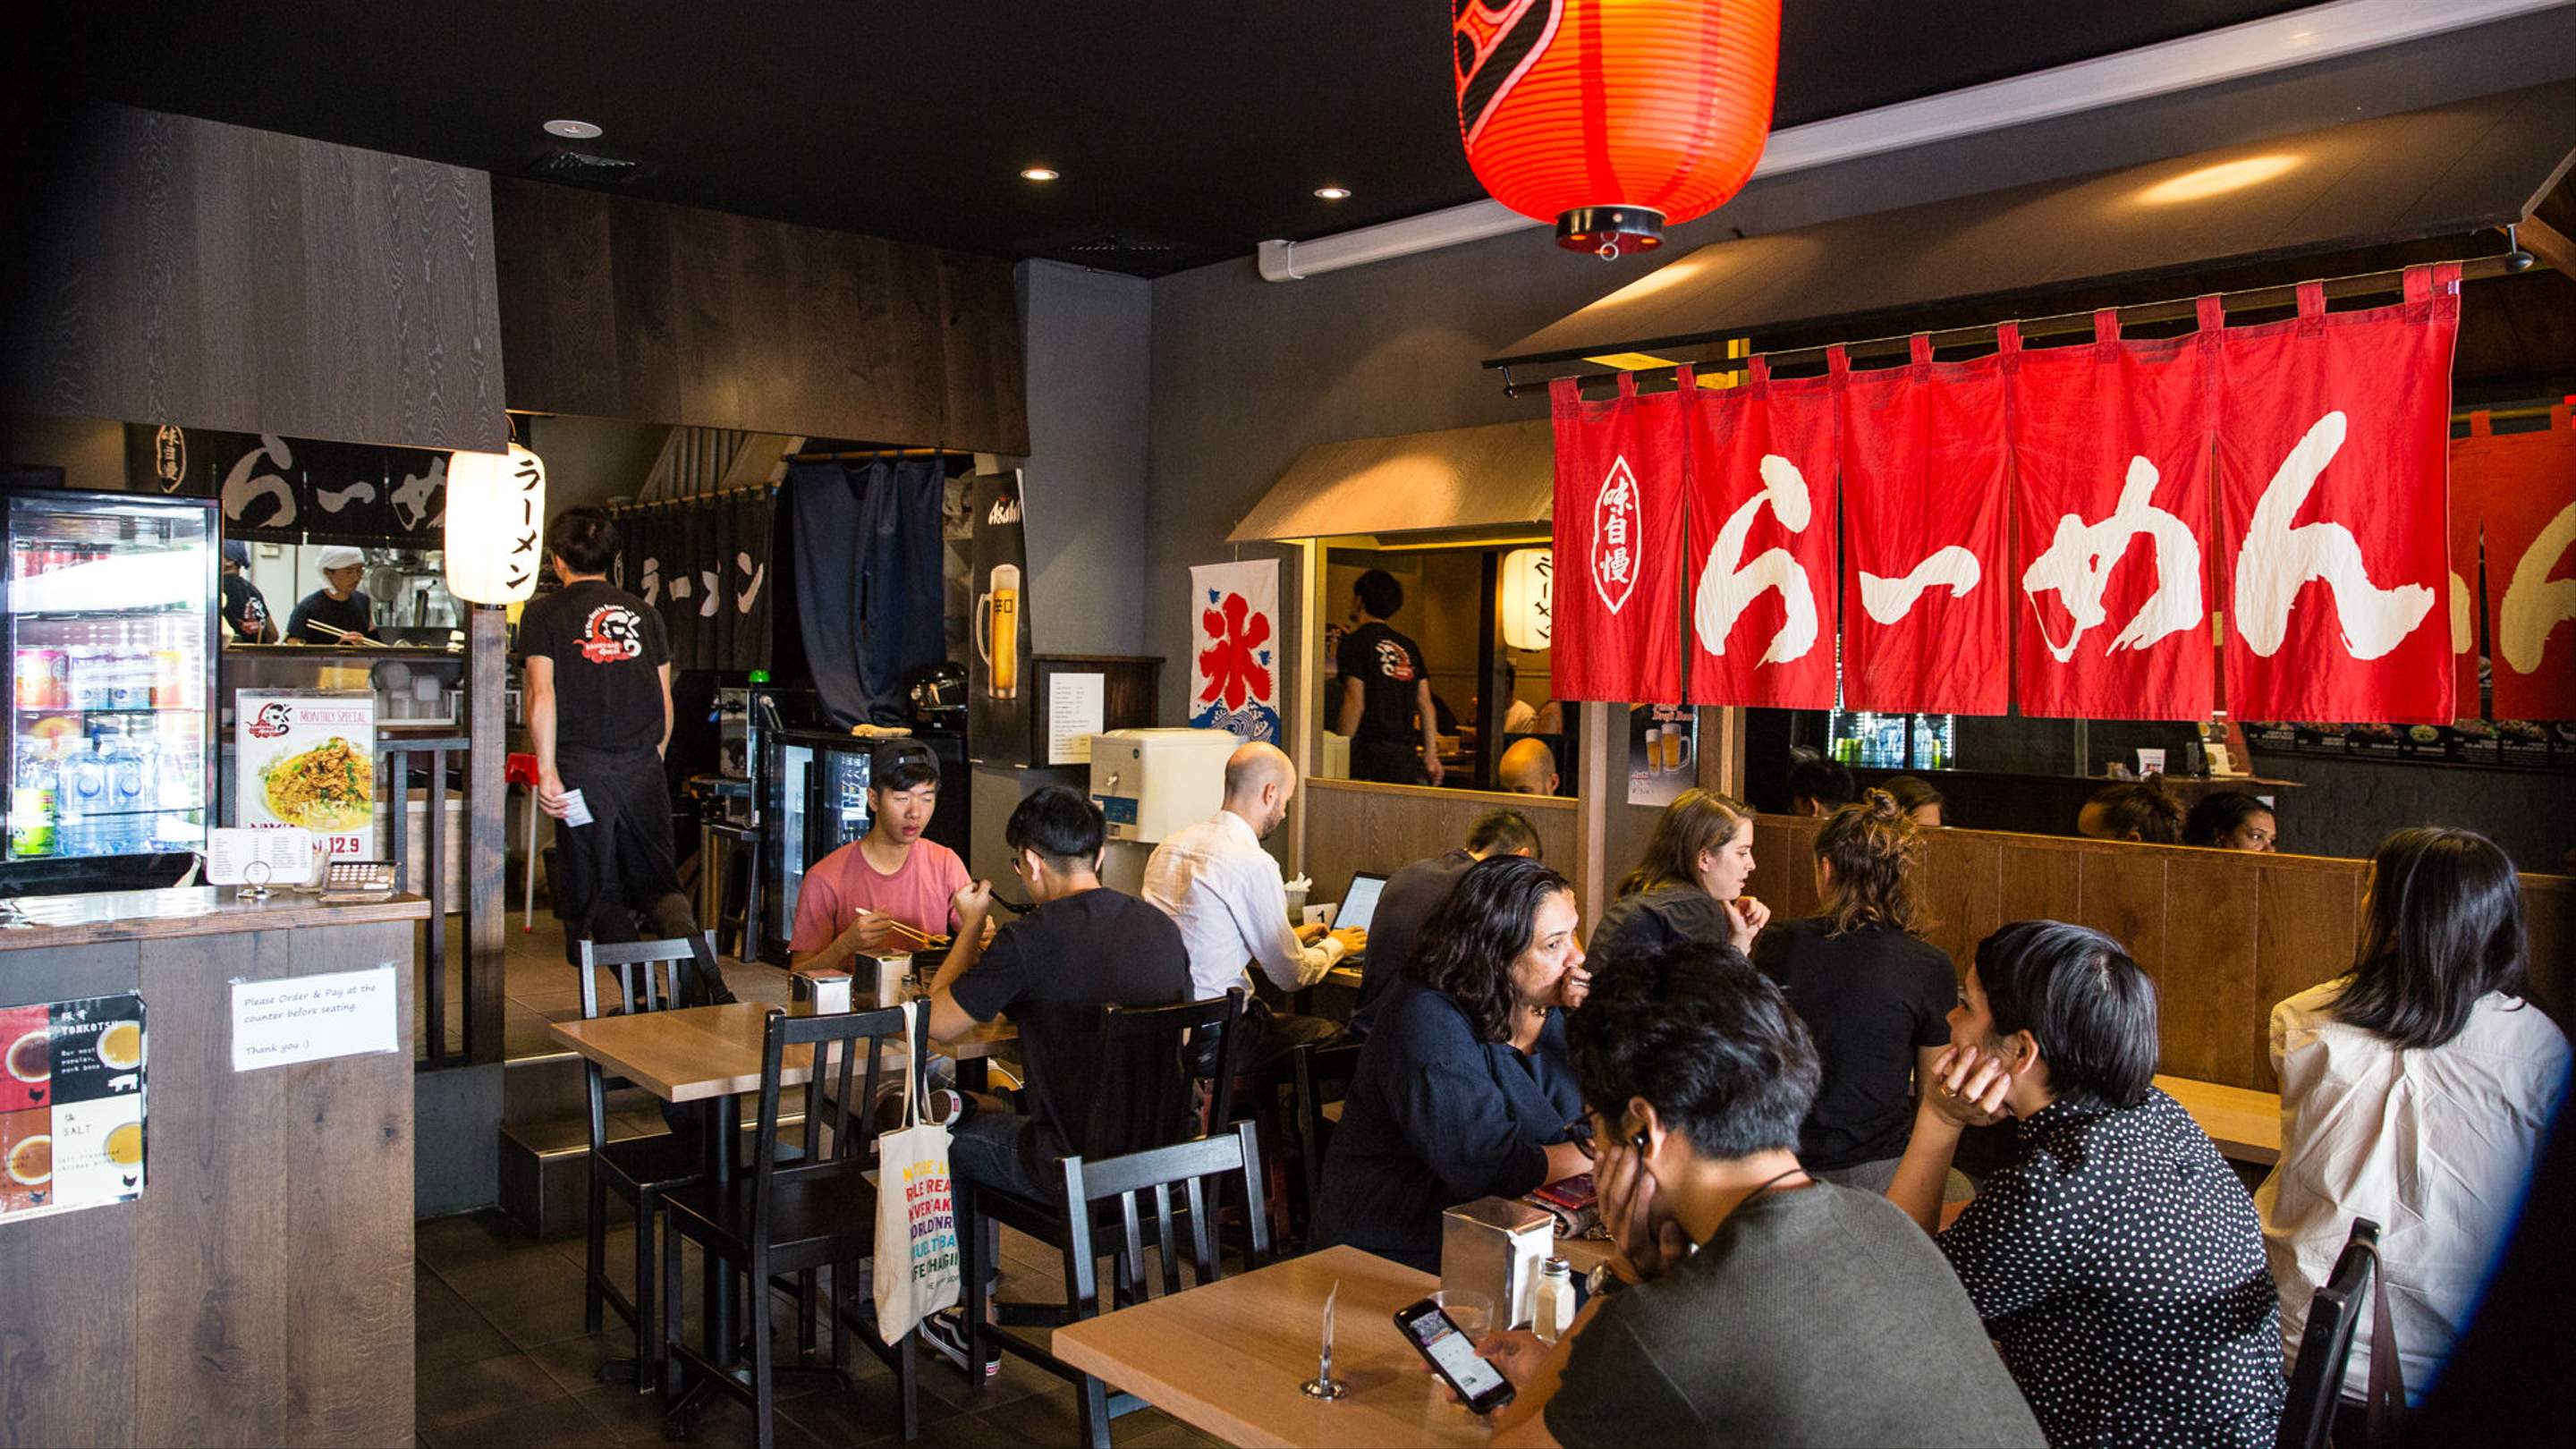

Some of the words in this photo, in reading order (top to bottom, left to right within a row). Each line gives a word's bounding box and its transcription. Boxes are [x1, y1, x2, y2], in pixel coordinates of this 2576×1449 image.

[506, 459, 541, 589] ラーメン
[1599, 476, 1633, 584] 味自慢
[1694, 410, 2436, 668] らーめん
[1199, 592, 1272, 712] 氷
[244, 996, 275, 1006] Please
[279, 992, 309, 1003] Order
[313, 990, 321, 999] &
[325, 988, 343, 998] Pay
[347, 987, 357, 995] at
[360, 984, 376, 993] the
[244, 1013, 282, 1023] counter
[287, 1006, 318, 1018] before
[246, 1044, 277, 1055] Thank
[281, 1041, 299, 1053] you
